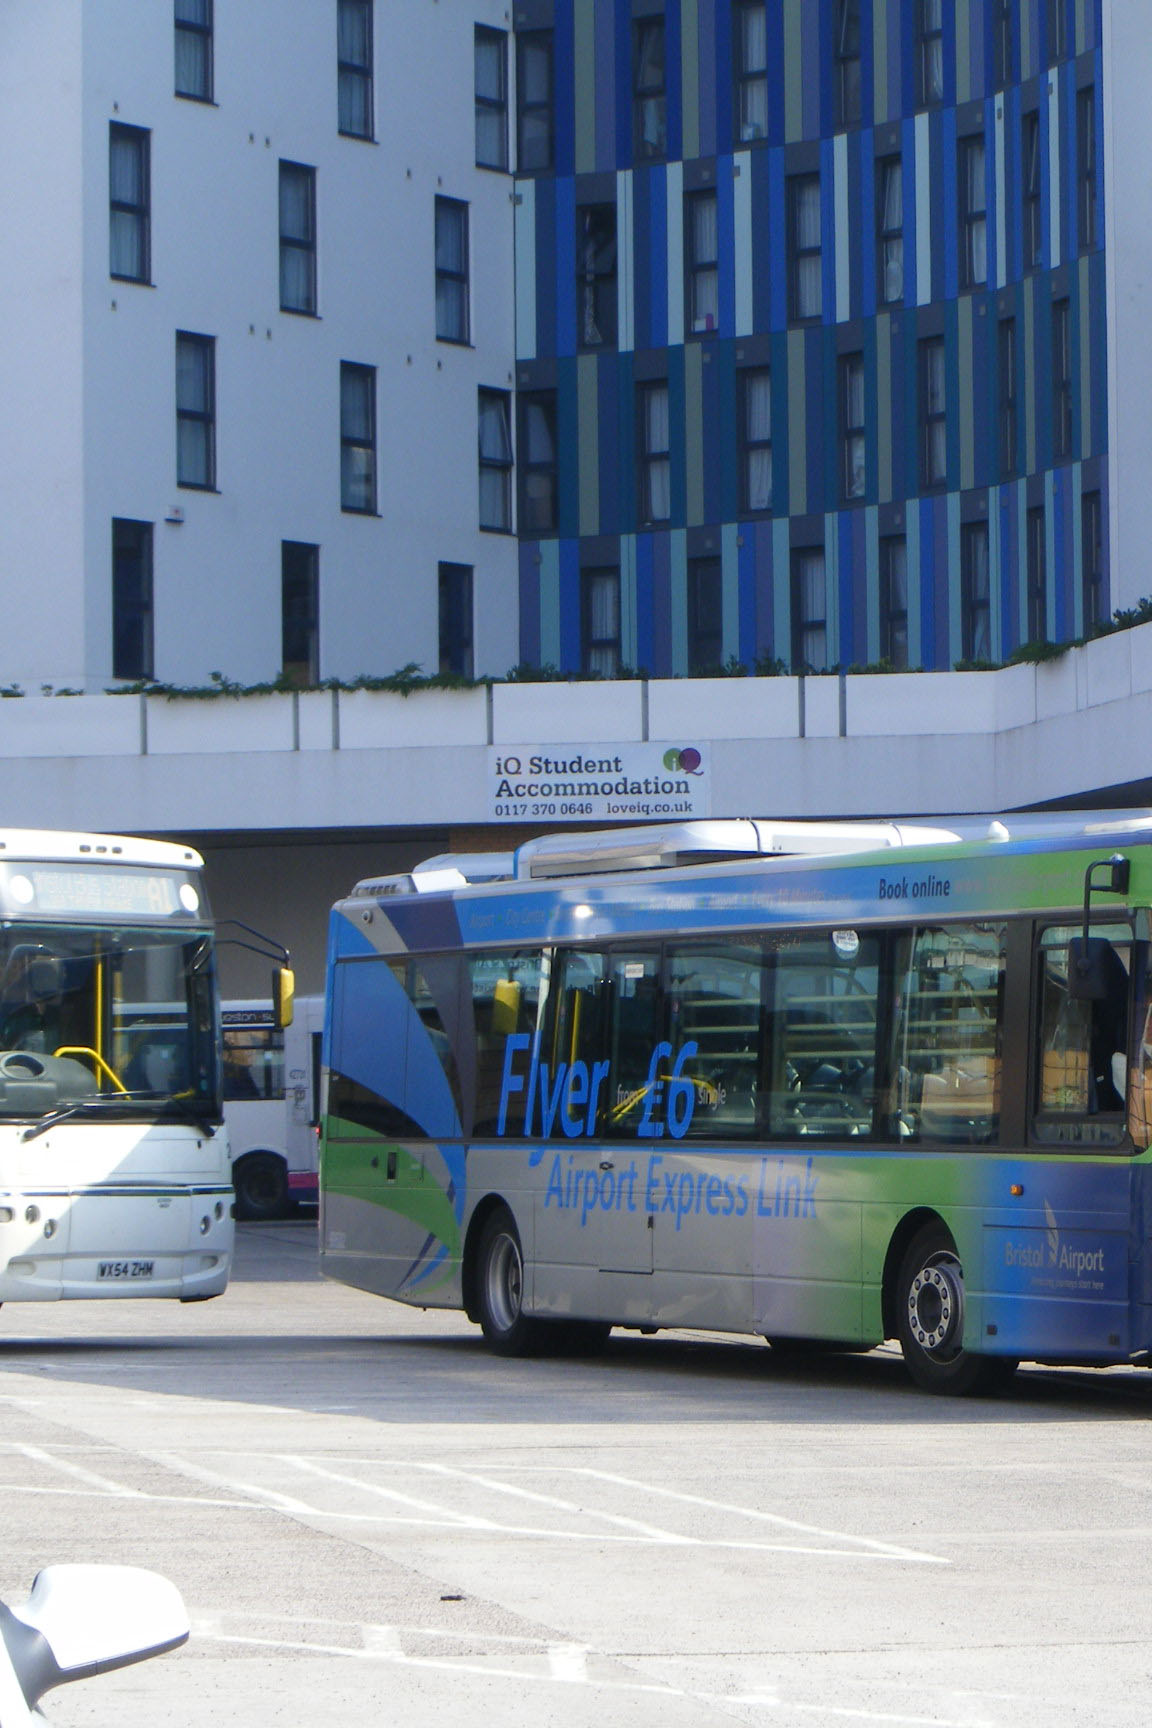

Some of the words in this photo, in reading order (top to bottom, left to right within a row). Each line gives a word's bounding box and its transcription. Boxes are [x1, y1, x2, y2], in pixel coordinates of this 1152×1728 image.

[496, 756, 522, 776] iQ
[529, 755, 623, 774] Student
[495, 776, 690, 798] Accommodation
[495, 804, 527, 816] 0117
[532, 803, 556, 816] 370
[560, 802, 593, 815] 0646
[607, 801, 692, 815] loveiq.co.uk
[879, 877, 908, 899] Book
[912, 875, 951, 897] online
[497, 1031, 610, 1168] Flyer
[637, 1041, 699, 1139] £6
[697, 1082, 727, 1110] single
[544, 1153, 639, 1228] Airport
[644, 1155, 749, 1232] Express
[756, 1156, 820, 1219] Link
[1004, 1241, 1044, 1267] Bristol
[1059, 1246, 1104, 1277] Airport
